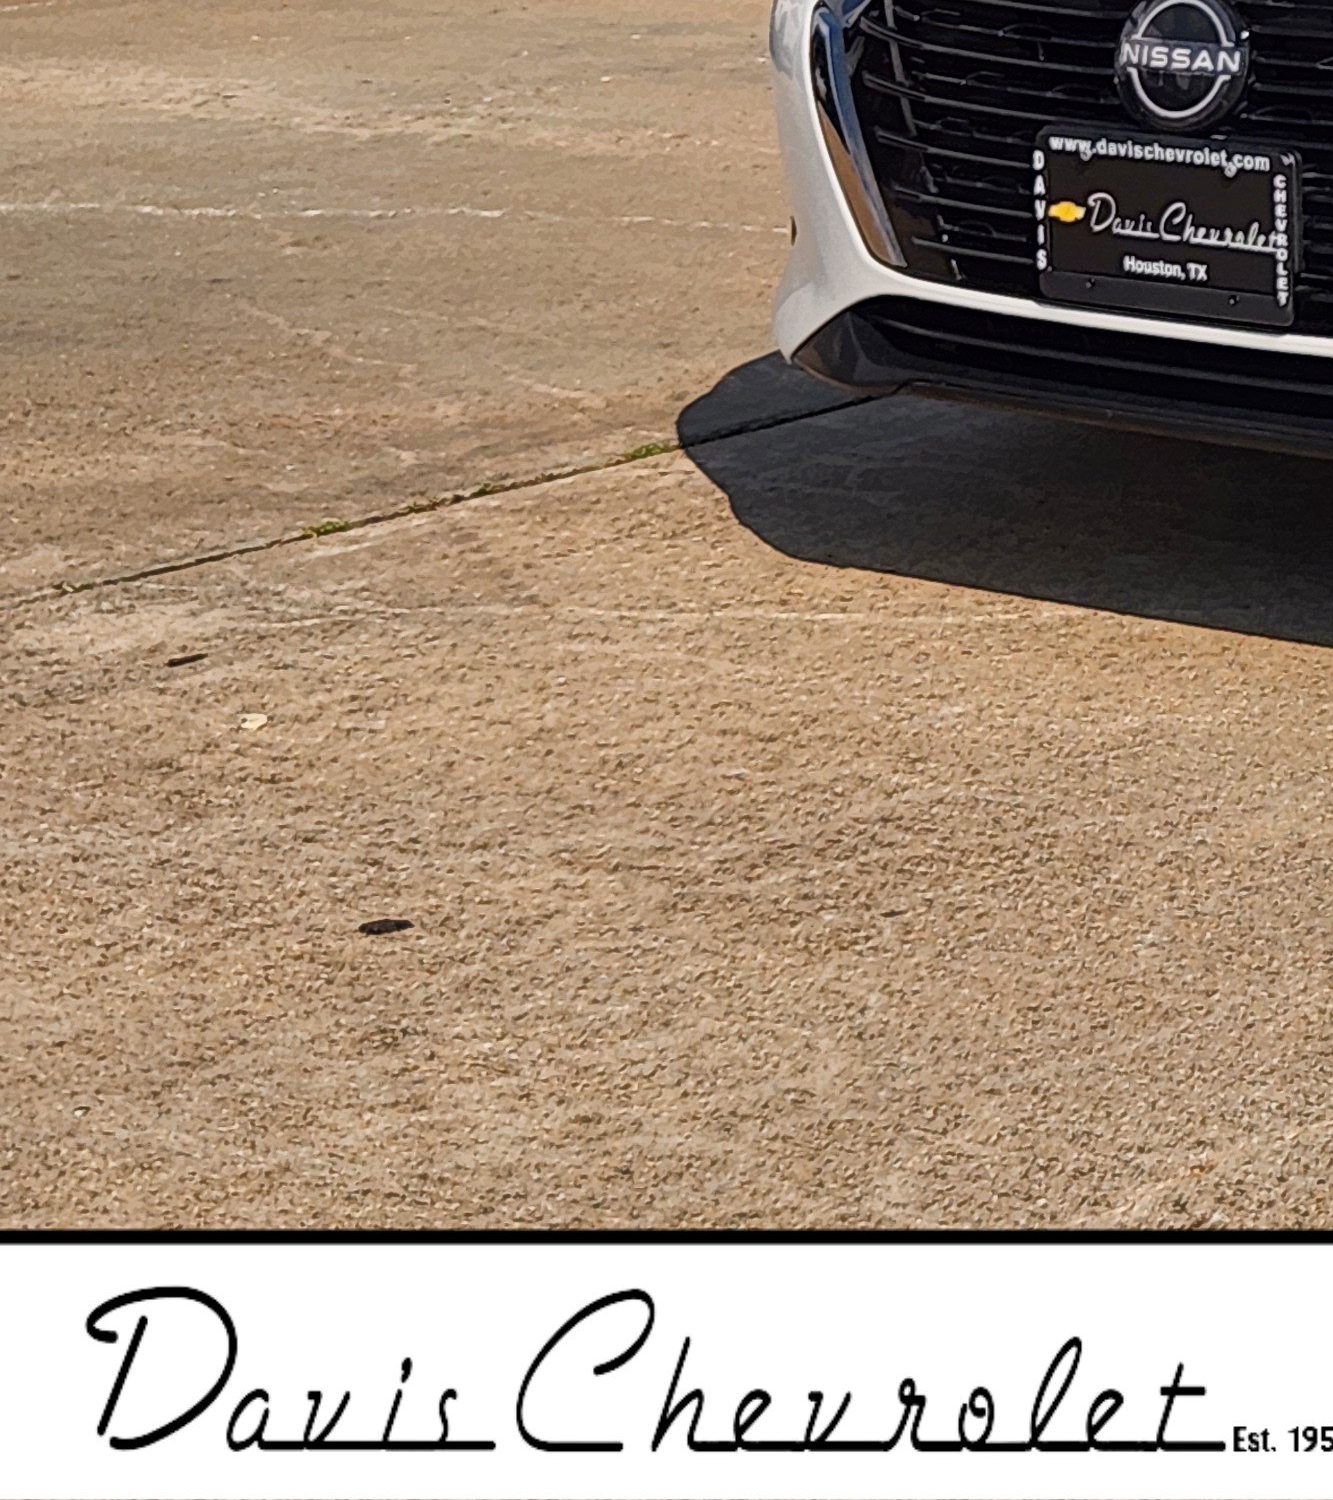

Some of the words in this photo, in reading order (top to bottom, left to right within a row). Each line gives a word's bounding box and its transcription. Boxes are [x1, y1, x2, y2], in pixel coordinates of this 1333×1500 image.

[1120, 41, 1241, 72] NISSAN
[1049, 136, 1271, 172] www.davischevrolet.com
[1032, 150, 1048, 271] DAVIS
[1087, 192, 1159, 239] Davis
[1158, 202, 1279, 254] Chevrolet
[1273, 174, 1288, 307] CHEVROLET
[1122, 255, 1186, 279] Houston,
[1187, 262, 1209, 282] TX
